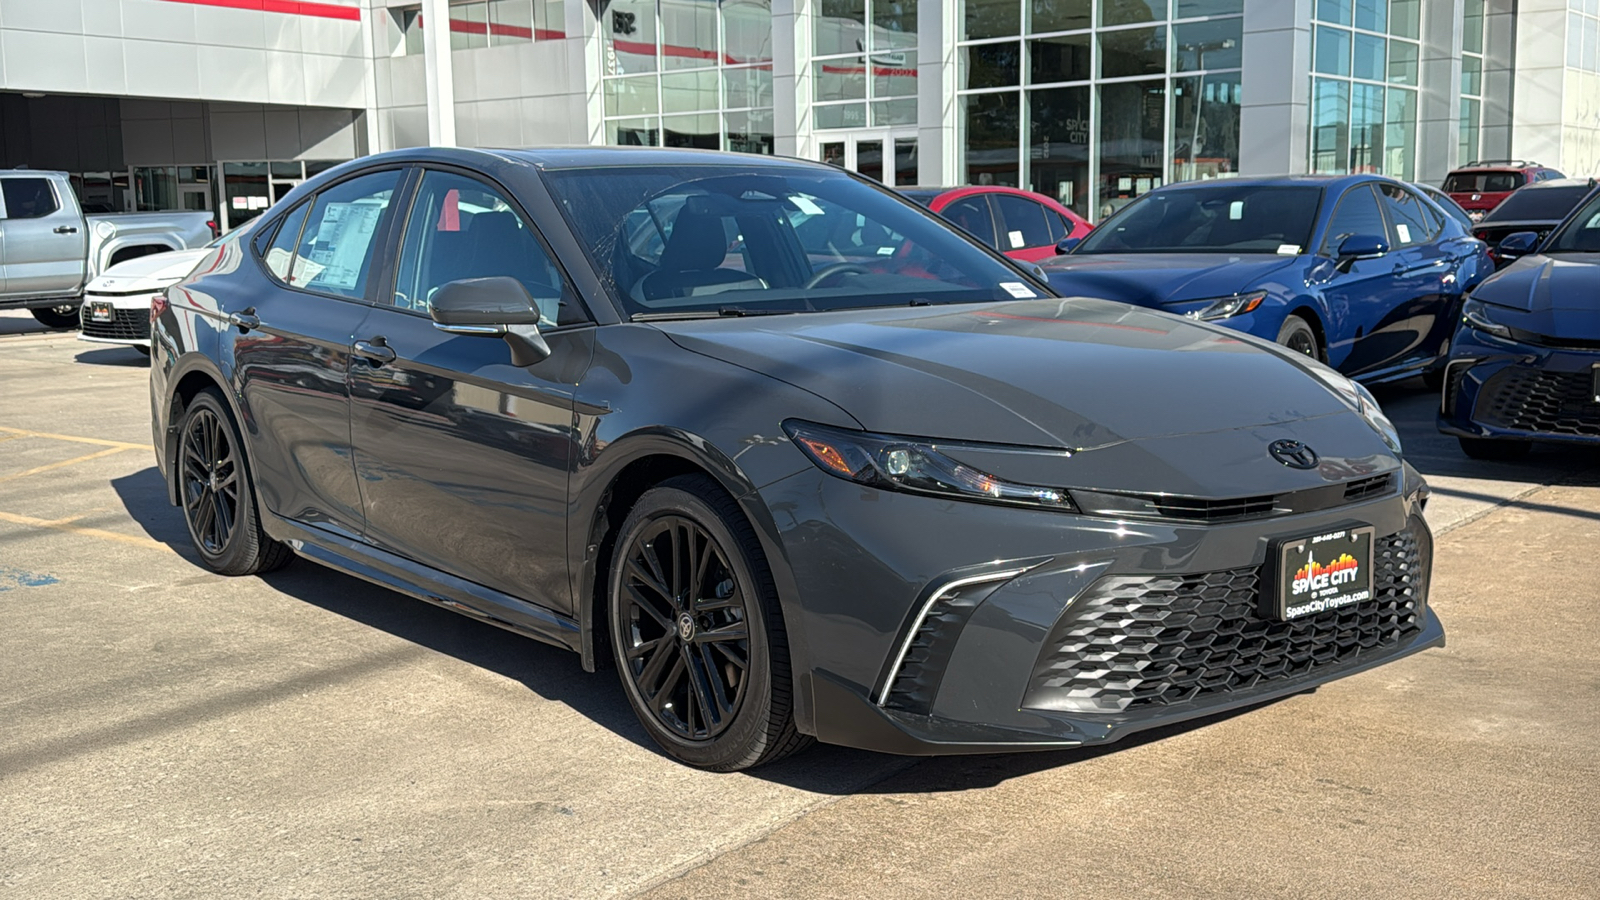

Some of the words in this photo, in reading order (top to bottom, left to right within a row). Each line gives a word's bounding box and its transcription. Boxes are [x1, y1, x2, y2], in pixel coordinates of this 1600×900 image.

[1070, 131, 1088, 144] CITY
[1330, 567, 1358, 585] CITY
[1319, 588, 1338, 597] TOYOTA
[1286, 590, 1369, 618] SpaceCityToyota.com
